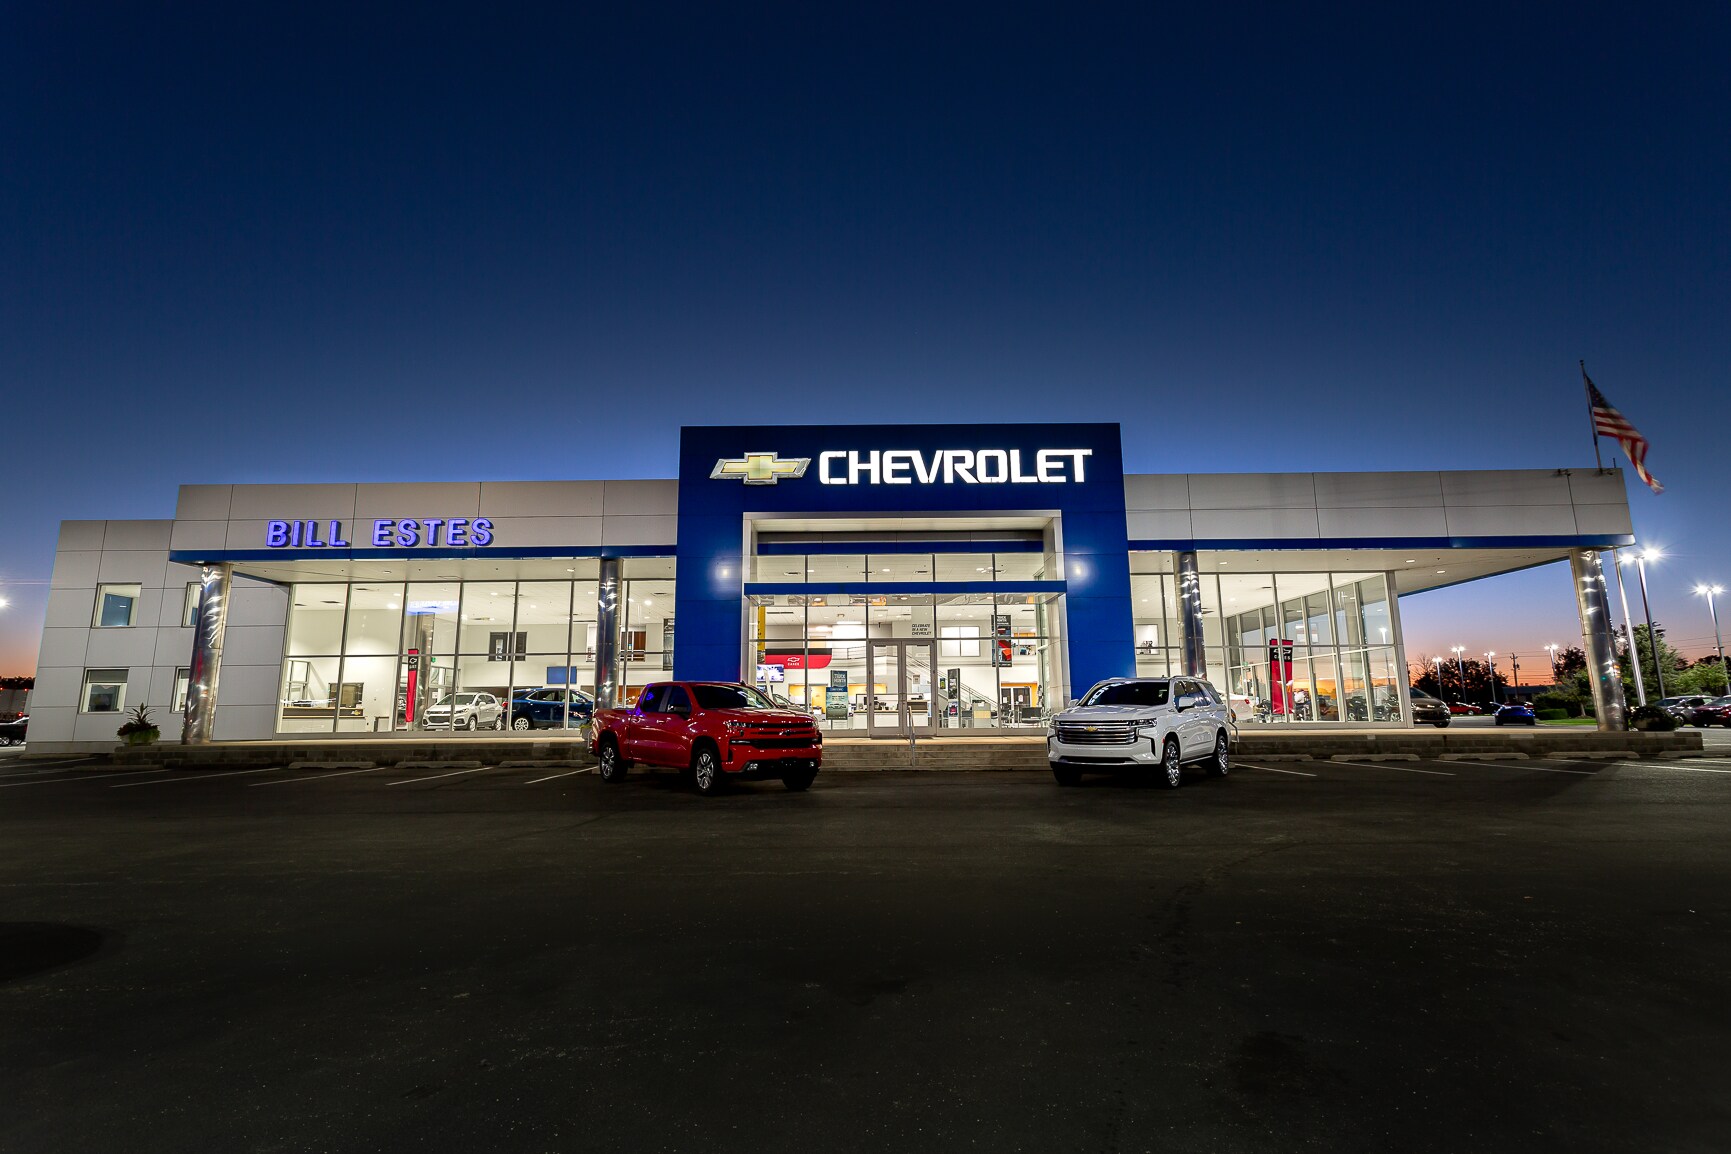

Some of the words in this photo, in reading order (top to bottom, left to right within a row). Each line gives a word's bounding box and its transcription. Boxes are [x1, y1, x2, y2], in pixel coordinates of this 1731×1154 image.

[819, 449, 1092, 485] CHEVROLET
[266, 519, 350, 547] BILL
[373, 518, 493, 547] ESTES
